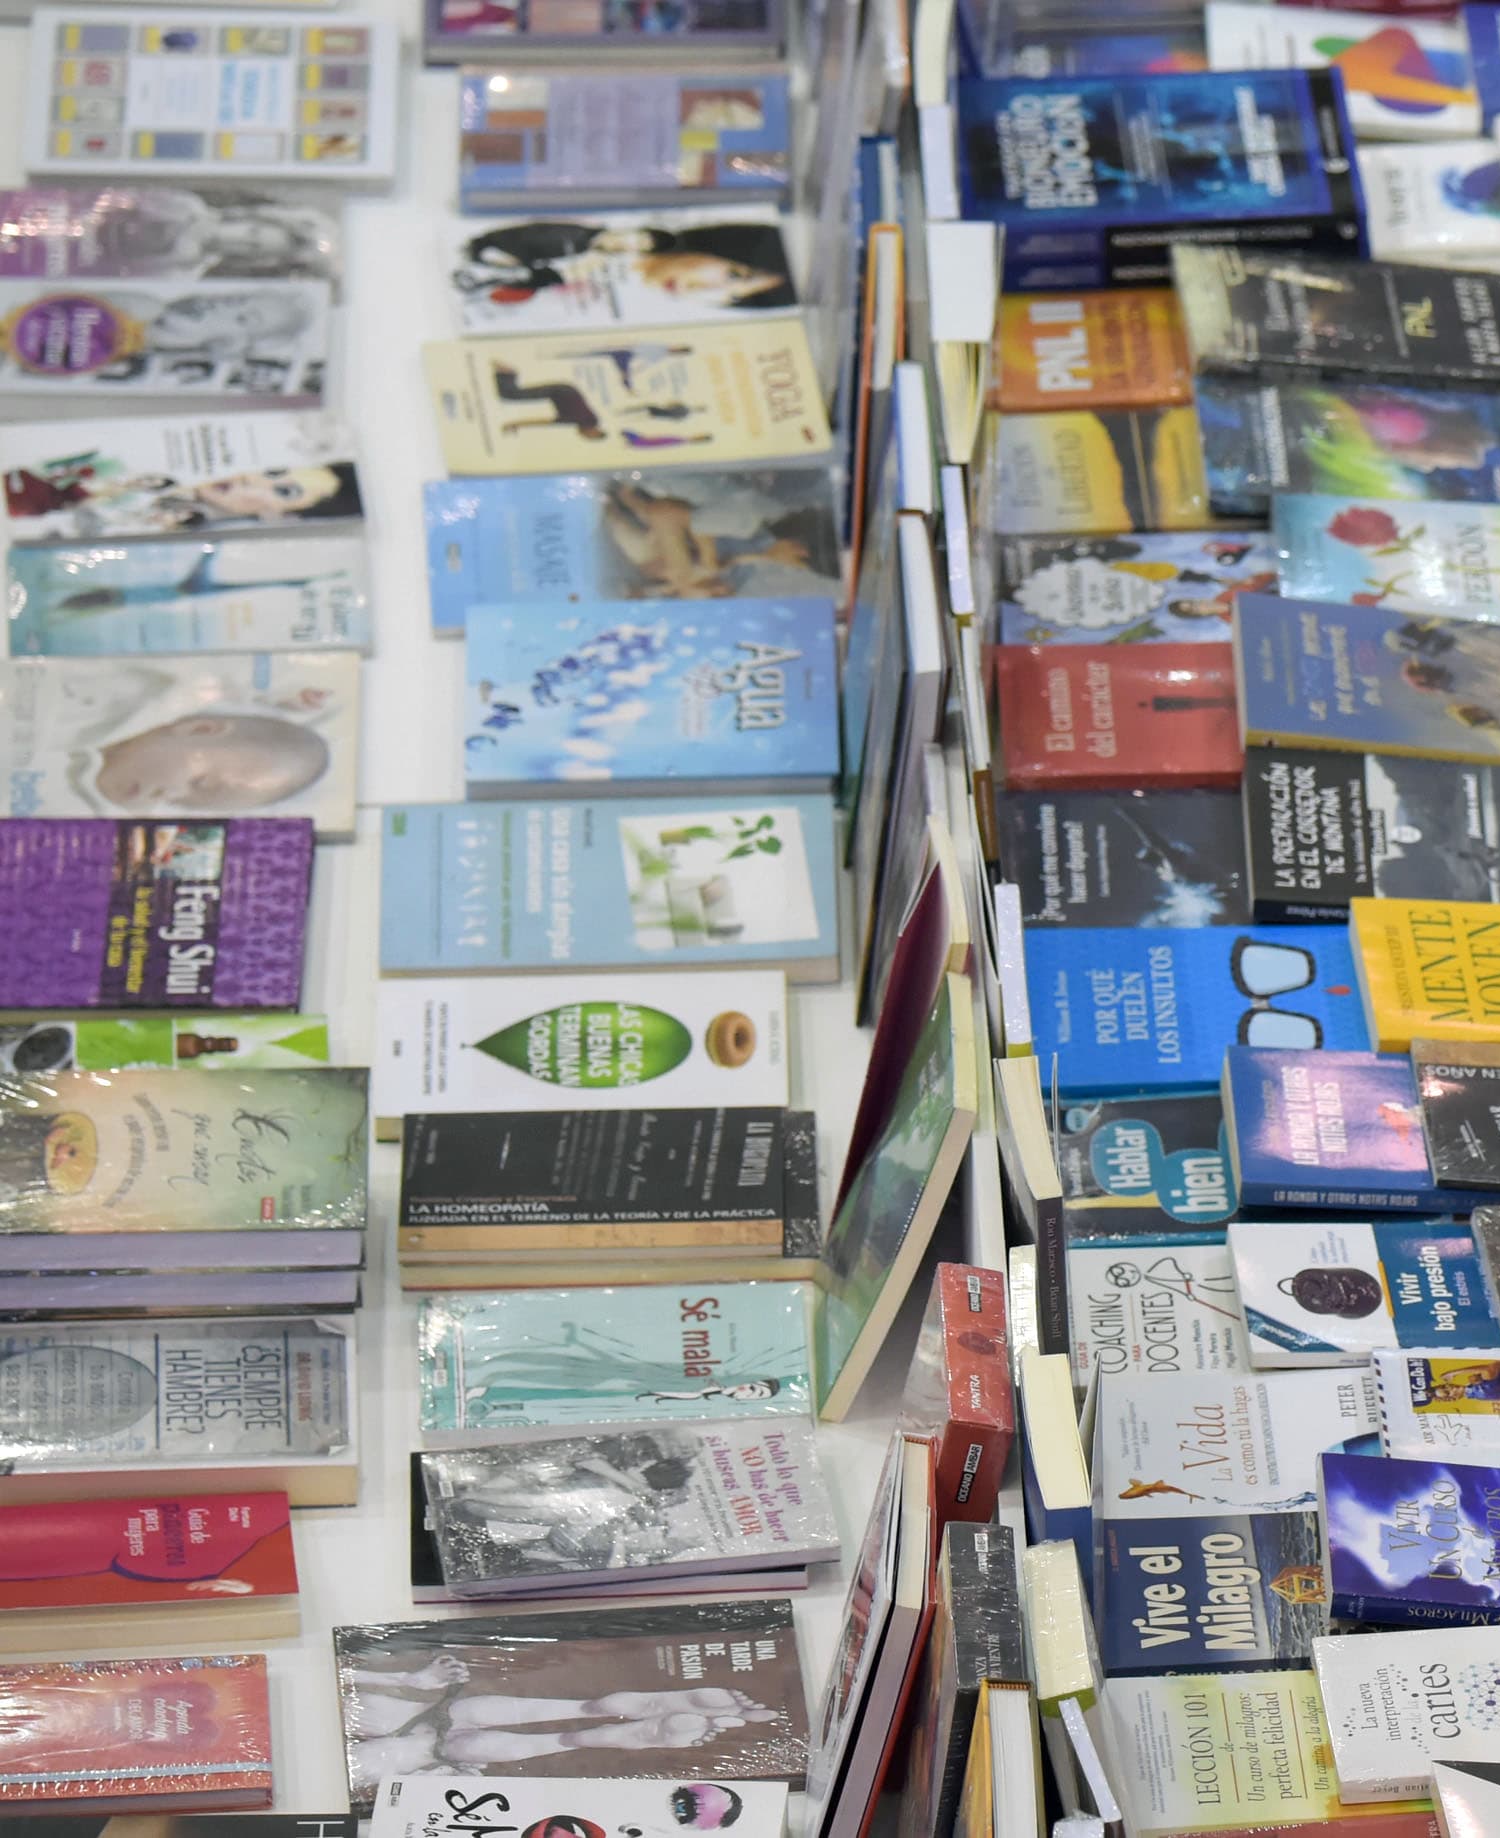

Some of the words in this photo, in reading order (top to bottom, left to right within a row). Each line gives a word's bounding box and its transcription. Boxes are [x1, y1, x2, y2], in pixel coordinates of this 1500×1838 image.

[716, 640, 804, 732] Agua
[1041, 667, 1073, 732] camino
[1044, 733, 1075, 752] El
[1260, 762, 1295, 865] PREPARACIÓN
[1067, 872, 1087, 904] hacer
[1274, 868, 1296, 887] LA
[158, 885, 219, 941] Feng
[165, 944, 215, 996] Shui
[1408, 909, 1474, 1024] MENTE
[1083, 968, 1125, 1006] QUÉ
[1147, 945, 1179, 1029] INSULTOS
[617, 1001, 643, 1026] LAS
[1120, 971, 1149, 1041] DUELEN
[1093, 1008, 1121, 1045] POR
[525, 1012, 555, 1079] GORDAS
[555, 1003, 583, 1086] TERMINAN
[586, 1012, 614, 1078] BUENAS
[617, 1030, 644, 1085] CHICAS
[1156, 1031, 1182, 1064] LOS
[1423, 1064, 1477, 1080] AÑOS
[1106, 1126, 1152, 1191] Hablar
[1170, 1156, 1229, 1215] bien
[409, 1203, 430, 1213] LA
[434, 1199, 550, 1213] HOMEOPATÍA
[1046, 1217, 1058, 1237] Ron
[1416, 1246, 1454, 1298] presión
[1396, 1273, 1424, 1306] Vivir
[680, 1296, 722, 1323] Sé
[1429, 1302, 1458, 1332] bajo
[1087, 1294, 1129, 1375] COACHING
[1140, 1292, 1181, 1374] DOCENTES
[681, 1330, 723, 1378] mala
[165, 1349, 205, 1434] HAMBRE?
[203, 1357, 242, 1419] TIENES
[241, 1346, 282, 1430] ¿SIEMPRE
[969, 1375, 982, 1410] TANTRA
[1227, 1386, 1252, 1416] hagas
[1337, 1385, 1358, 1419] PETER
[1176, 1404, 1231, 1471] Vida
[1232, 1417, 1249, 1428] la
[704, 1436, 729, 1447] si
[741, 1446, 766, 1467] NO
[763, 1433, 790, 1464] Todo
[1235, 1444, 1256, 1473] como
[712, 1449, 741, 1490] buscas
[748, 1469, 769, 1490] has
[776, 1466, 800, 1479] lo
[1244, 1475, 1259, 1487] es
[757, 1493, 778, 1507] de
[775, 1482, 803, 1505] que
[187, 1508, 212, 1531] Guía
[729, 1495, 764, 1537] AMOR
[765, 1509, 790, 1542] hacer
[1388, 1500, 1424, 1552] VIVIR
[123, 1517, 146, 1557] mujeres
[190, 1531, 212, 1544] de
[1127, 1545, 1183, 1576] el
[1195, 1533, 1261, 1651] Milagro
[1131, 1583, 1191, 1650] Vive
[679, 1644, 708, 1680] PASIÓN
[704, 1642, 727, 1657] DE
[729, 1641, 754, 1672] TARDE
[754, 1640, 777, 1661] UNA
[1183, 1692, 1208, 1720] 101
[1232, 1690, 1260, 1741] milagros:
[1302, 1694, 1326, 1724] alegría
[1355, 1683, 1374, 1716] nueva
[1373, 1669, 1402, 1742] interpretación
[1418, 1664, 1463, 1741] caries
[145, 1697, 174, 1741] coaching
[168, 1699, 195, 1735] Agenda
[1253, 1690, 1287, 1745] felicidad
[1303, 1725, 1321, 1735] la
[1361, 1718, 1380, 1732] La
[1221, 1741, 1236, 1753] de
[1237, 1743, 1257, 1755] de
[1312, 1736, 1323, 1744] a
[1181, 1727, 1222, 1806] LECCIÓN
[1243, 1755, 1262, 1784] curso
[1261, 1748, 1303, 1802] perfecta
[1311, 1746, 1327, 1776] camino
[1244, 1786, 1267, 1804] Un
[1314, 1777, 1331, 1792] Un
[444, 1789, 511, 1823] Sé
